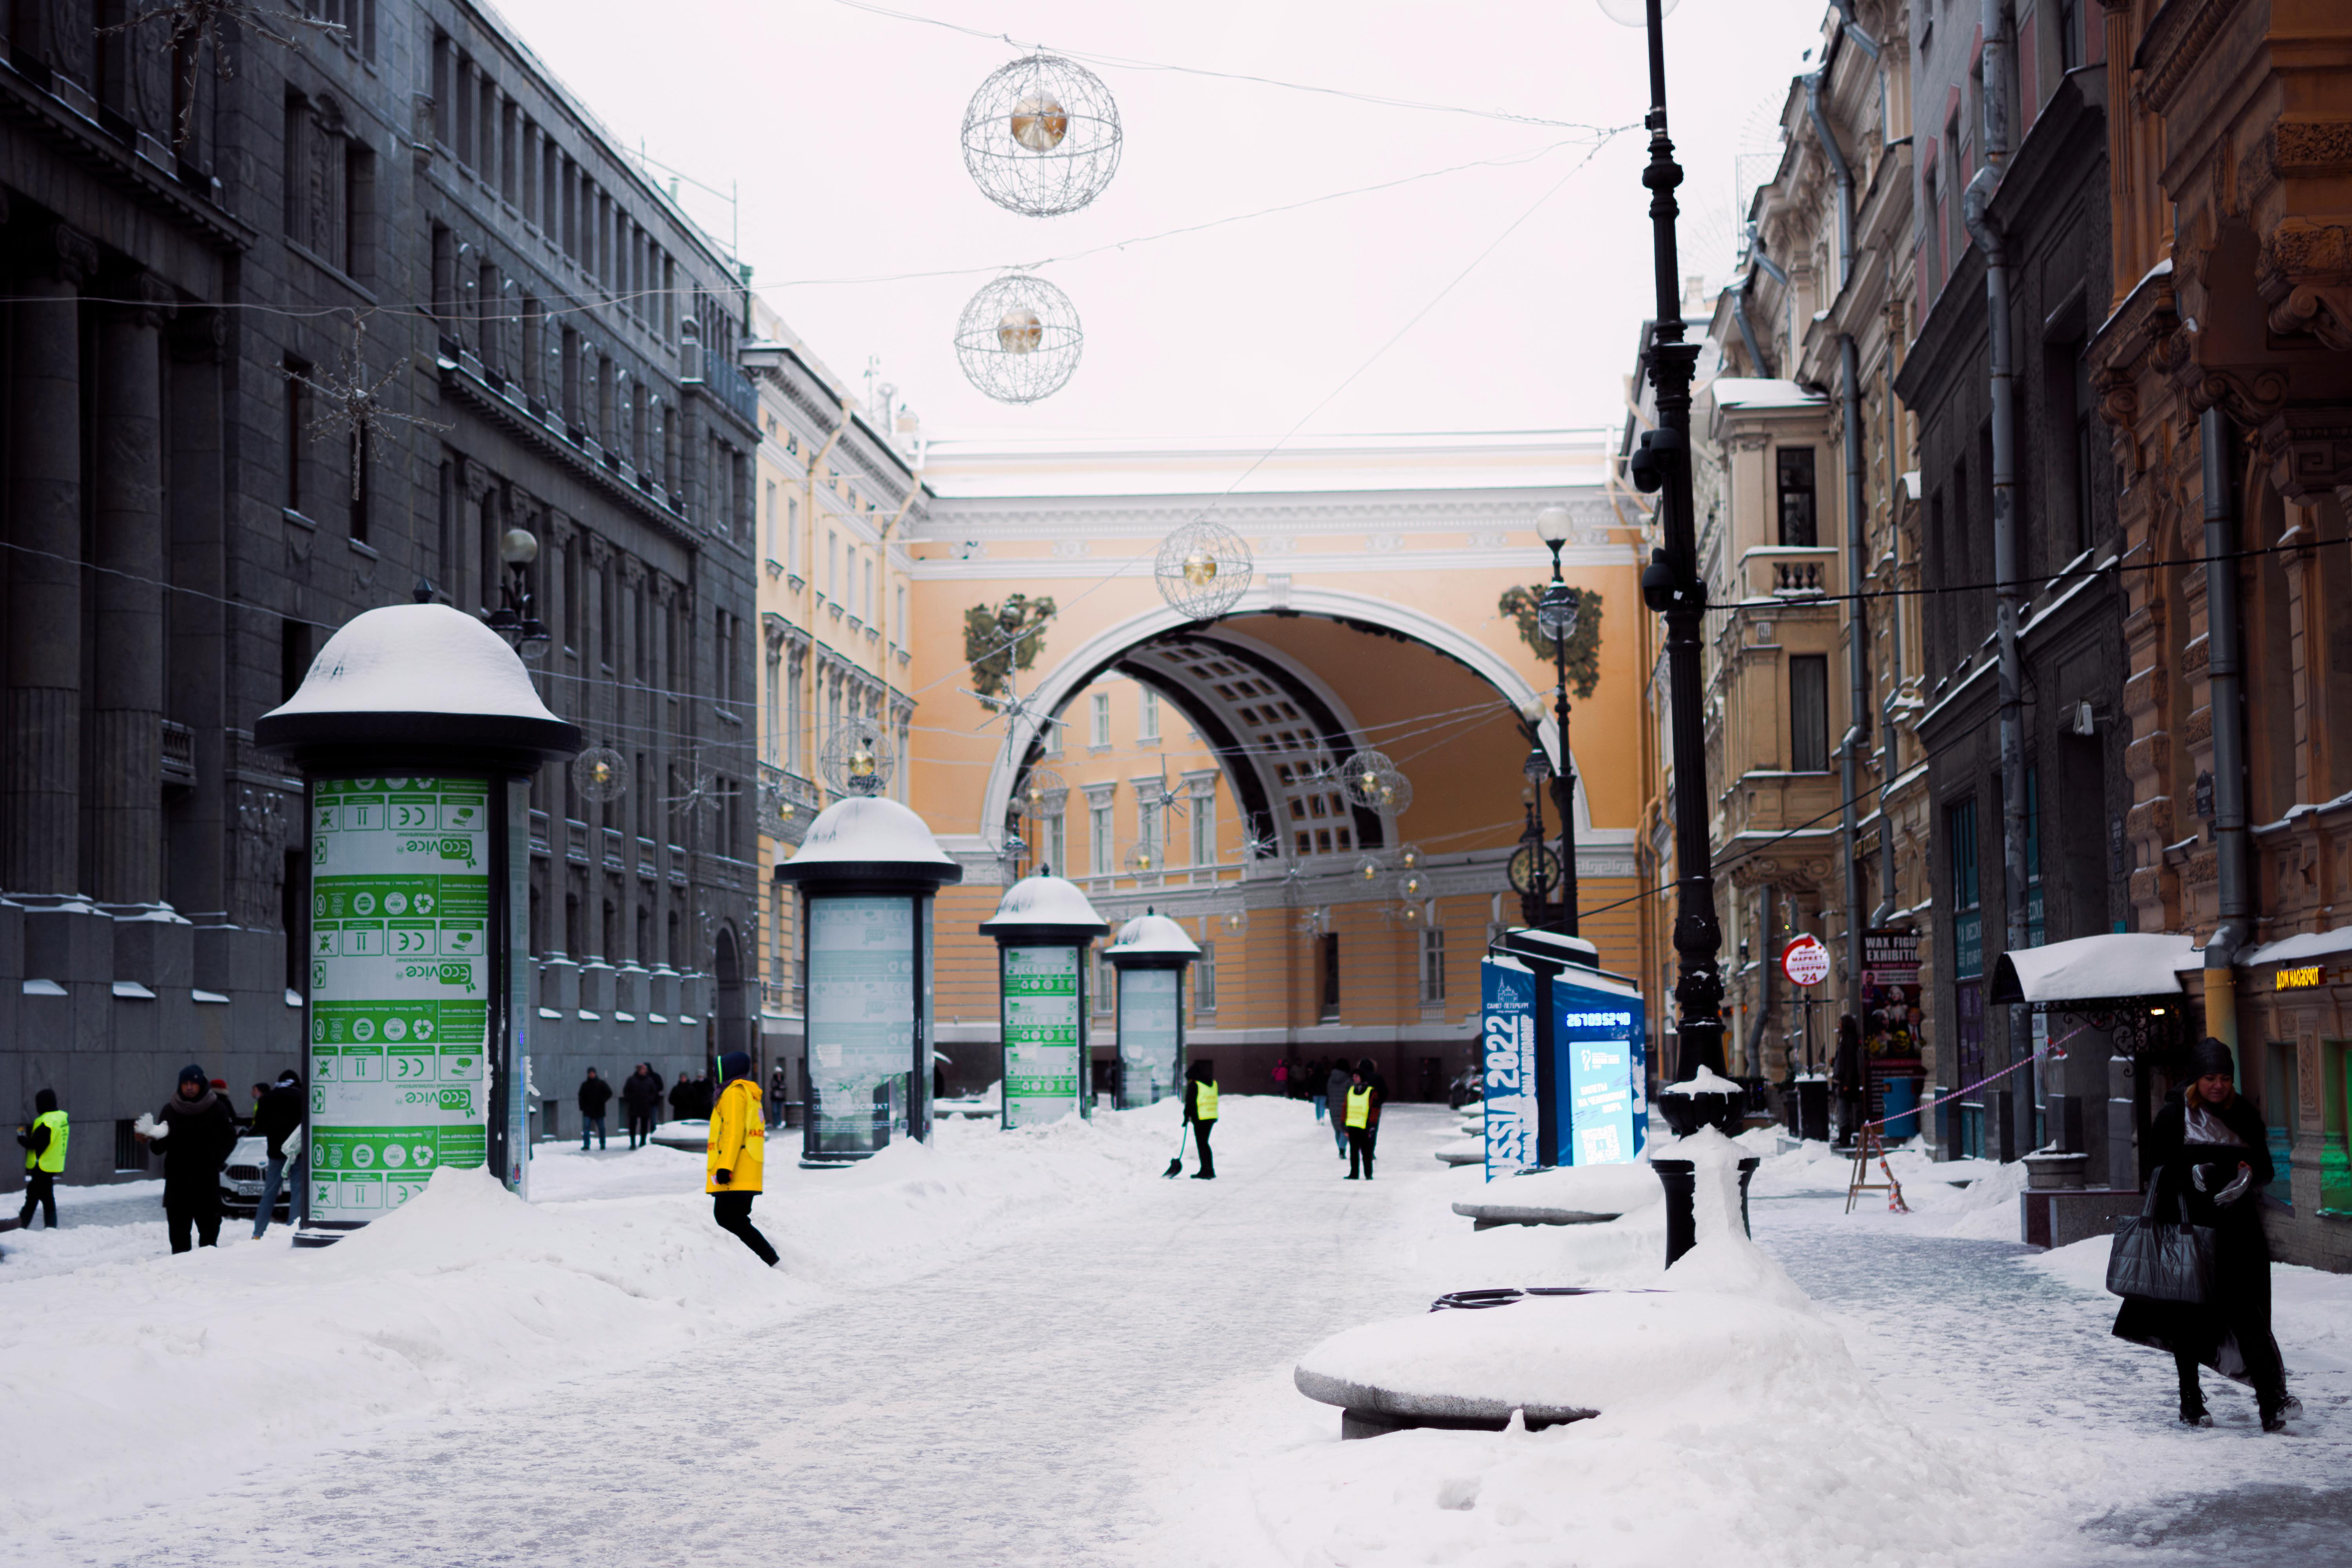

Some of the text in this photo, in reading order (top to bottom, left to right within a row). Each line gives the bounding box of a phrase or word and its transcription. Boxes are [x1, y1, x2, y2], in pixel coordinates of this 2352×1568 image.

[1865, 937, 1889, 948] WAX
[1802, 973, 1817, 982] 24
[1486, 1016, 1520, 1088] 2022
[1580, 1082, 1608, 1095] БИЛЕТЫ
[1577, 1090, 1627, 1108] НА ЧЕМПИОНАТ
[1602, 1102, 1622, 1114] МИРА
